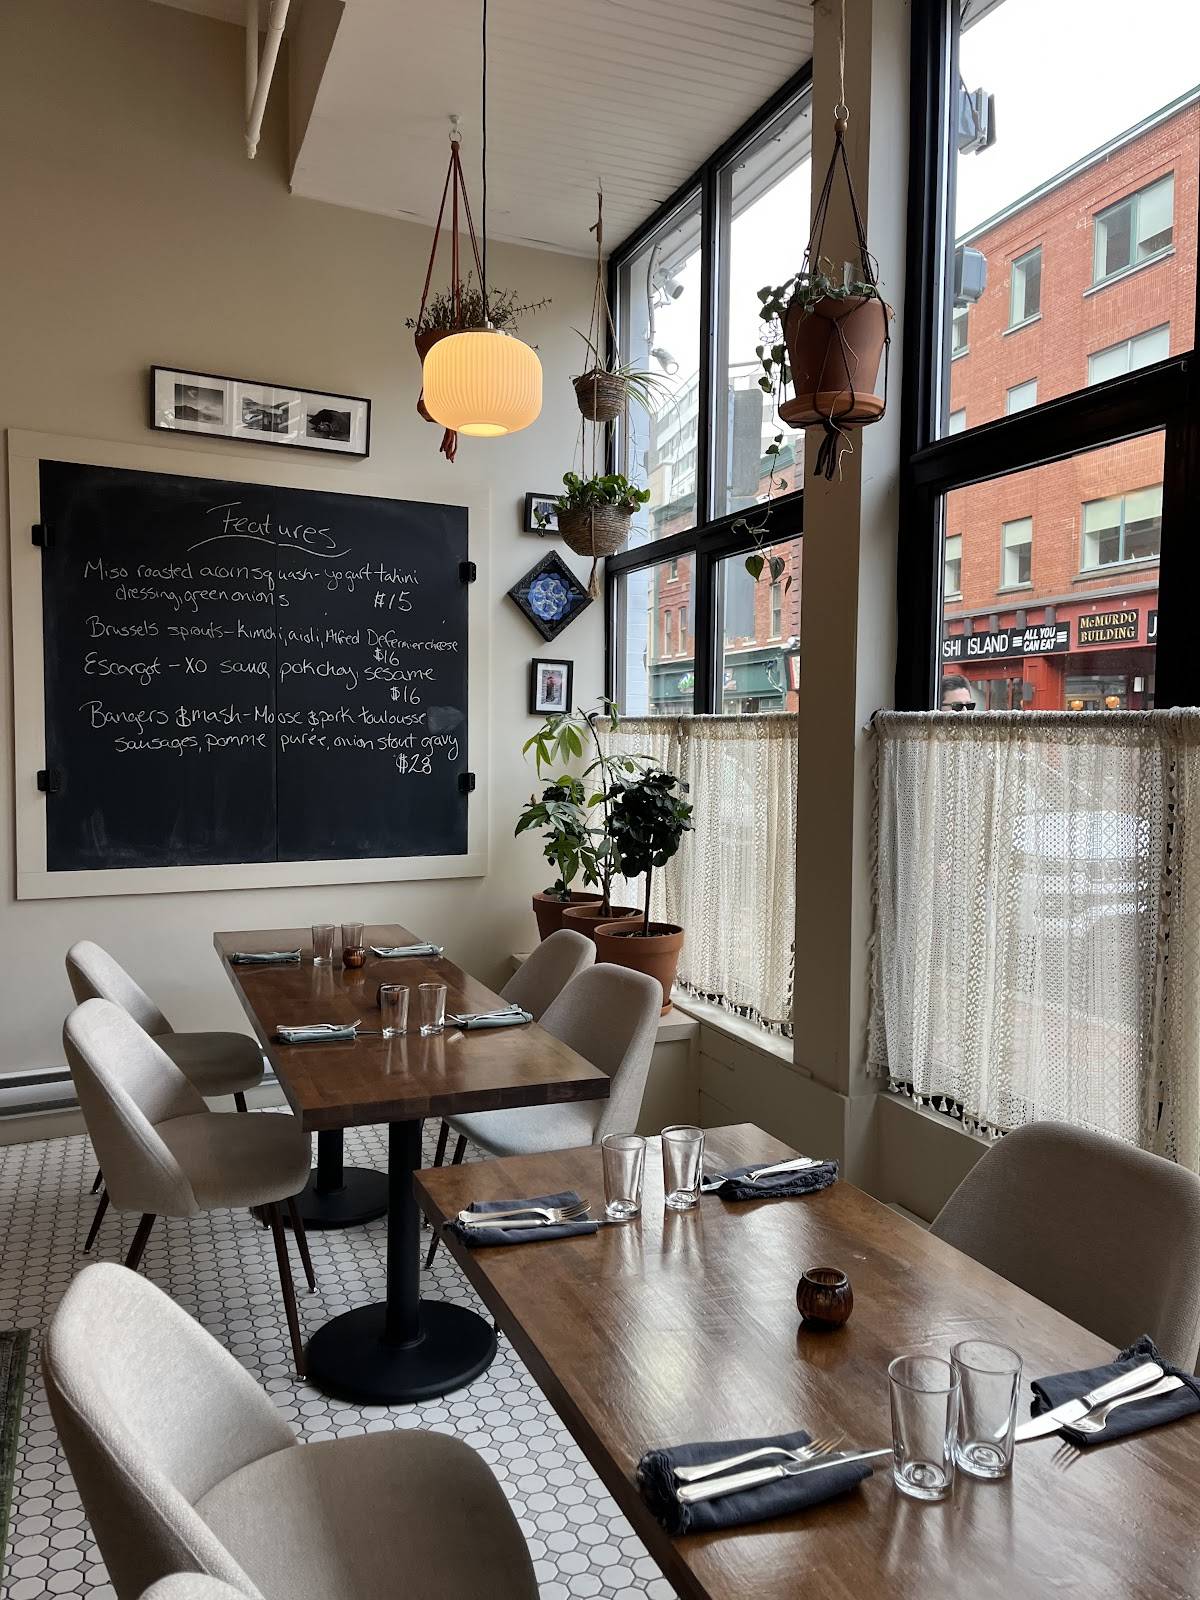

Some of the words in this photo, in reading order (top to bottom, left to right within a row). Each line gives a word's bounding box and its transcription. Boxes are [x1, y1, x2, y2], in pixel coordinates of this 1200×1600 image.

[206, 501, 336, 548] Features
[84, 558, 128, 580] Miso
[137, 563, 193, 579] roasted
[200, 565, 249, 579] acorn
[374, 563, 419, 585] tahini
[231, 589, 290, 607] onions
[86, 615, 160, 638] Brussels
[325, 628, 360, 645] Alfred
[1080, 611, 1137, 629] McMURDO
[1023, 629, 1039, 641] ALL
[1039, 626, 1056, 638] YOU
[1080, 626, 1135, 643] BUILDING
[967, 634, 1009, 655] ISLAND
[1023, 641, 1040, 652] CAN
[1040, 638, 1056, 651] EAT
[373, 647, 400, 667] $16
[185, 656, 208, 674] XO
[364, 667, 436, 681] sesame
[390, 686, 421, 704] $16
[78, 700, 169, 735] Bangers
[254, 705, 304, 725] Moose
[203, 733, 268, 752] pomme
[333, 735, 374, 750] onion
[376, 732, 416, 750] stout
[420, 735, 459, 761] gravy
[395, 752, 432, 775] $28
